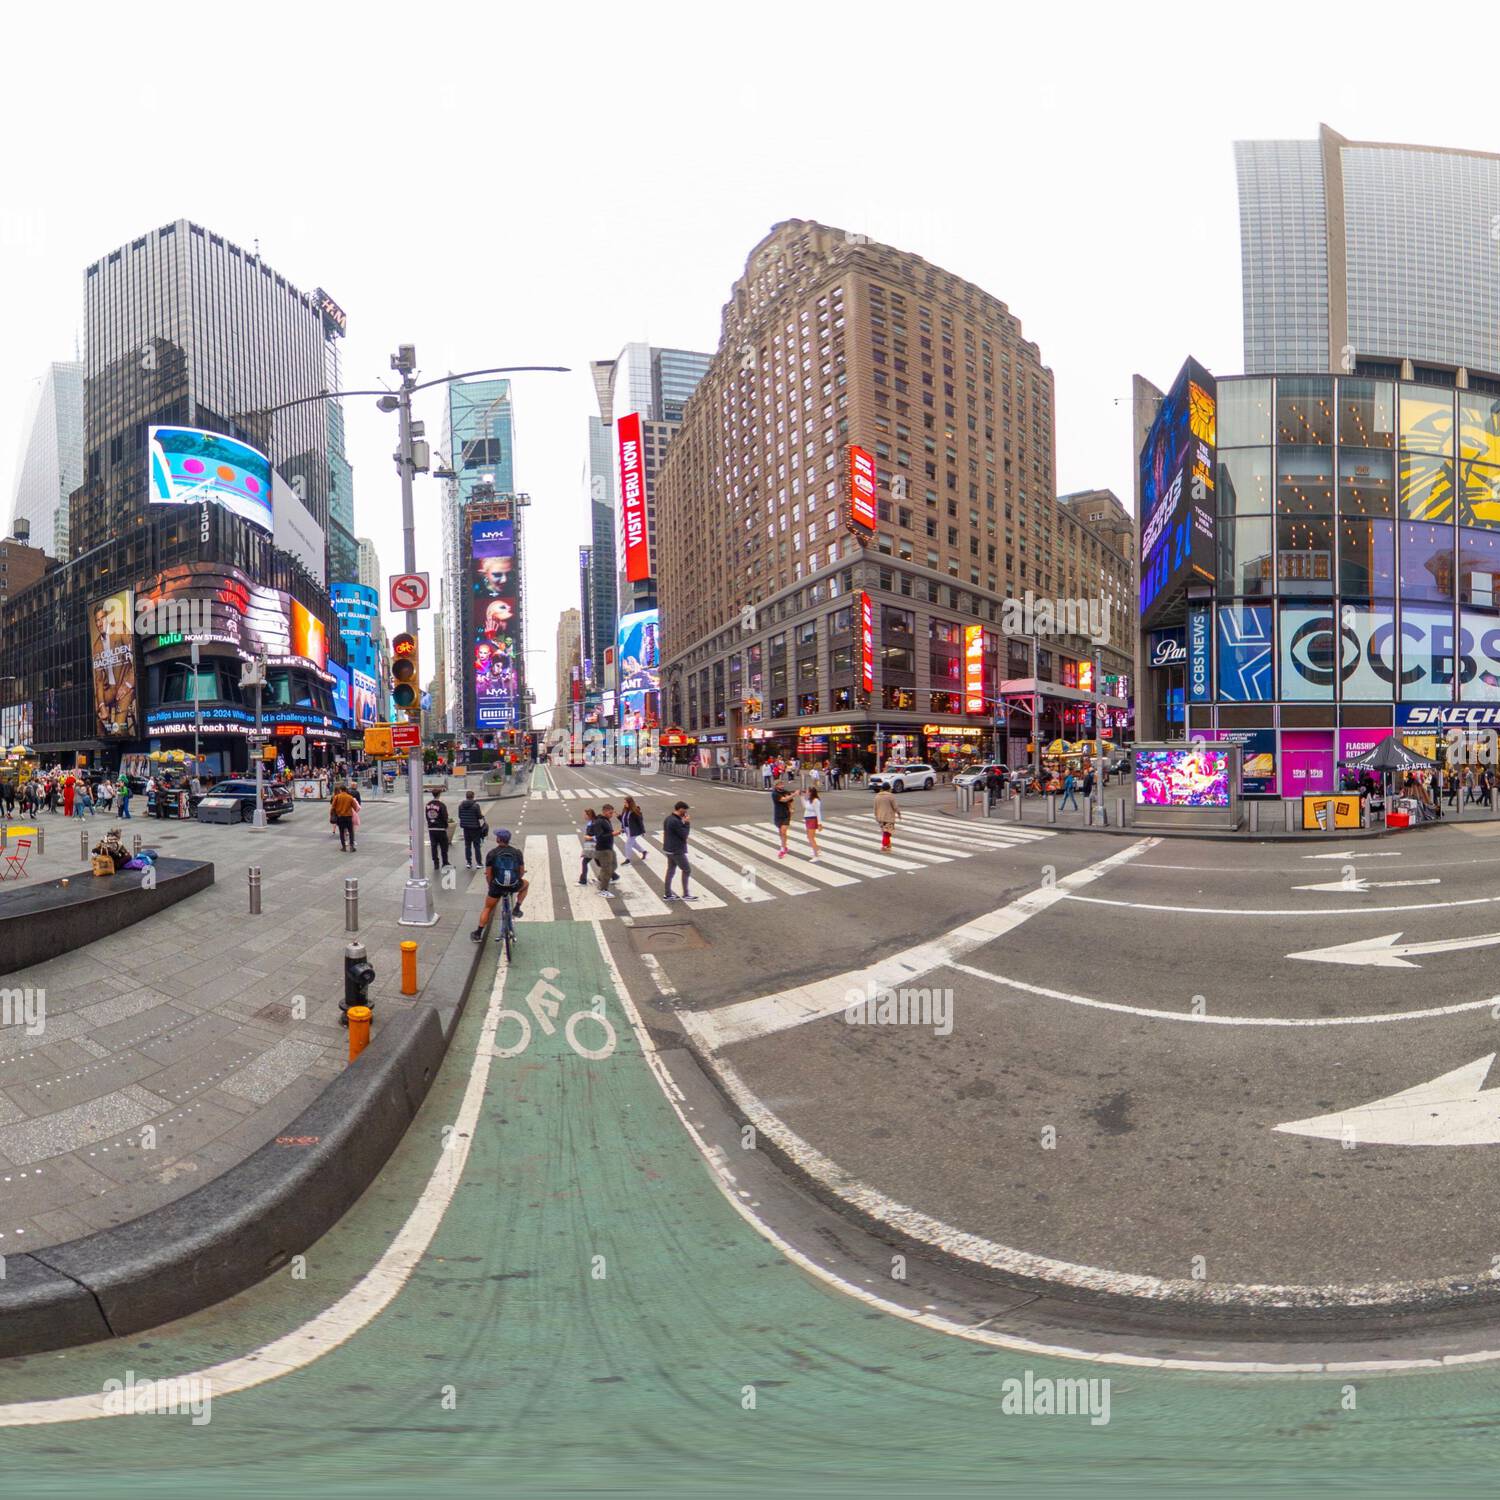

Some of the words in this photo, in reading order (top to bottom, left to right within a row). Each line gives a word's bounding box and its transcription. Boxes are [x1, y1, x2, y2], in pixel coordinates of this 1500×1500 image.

[623, 440, 637, 471] NOW
[626, 473, 640, 505] PERU
[482, 531, 503, 540] NYX
[628, 512, 643, 547] VISIT
[336, 598, 360, 606] NASDAQ
[159, 632, 181, 647] hulu
[1192, 615, 1205, 655] NEWS
[93, 652, 133, 669] BACHELR
[1192, 655, 1205, 683] CBS
[486, 688, 507, 697] NYX
[173, 711, 211, 720] launces
[213, 709, 232, 719] 2024
[276, 713, 307, 722] challenge
[165, 724, 187, 733] WNBA
[200, 723, 225, 733] reach
[226, 723, 239, 732] 10K
[1346, 742, 1376, 750] FLAGSHIP
[1396, 762, 1432, 772] SAG-AFTRA
